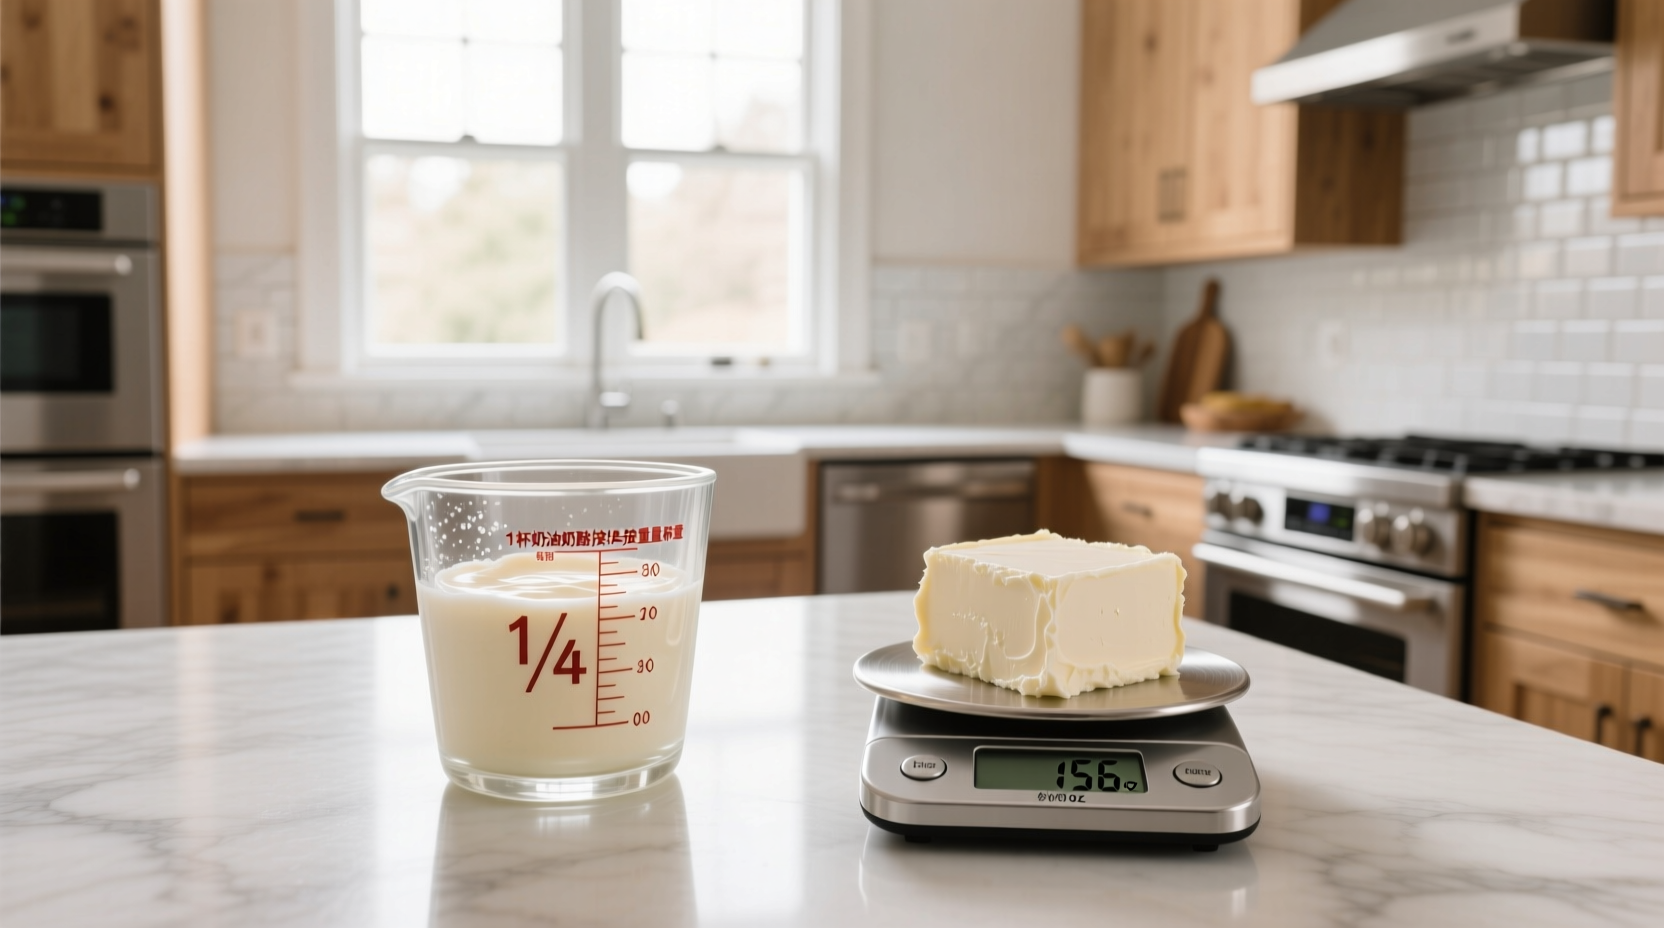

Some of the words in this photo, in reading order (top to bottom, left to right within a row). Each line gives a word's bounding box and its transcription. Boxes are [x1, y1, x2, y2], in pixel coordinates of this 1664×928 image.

[508, 612, 588, 693] 1/4
[632, 710, 651, 727] 00
[1056, 759, 1121, 792] 156
